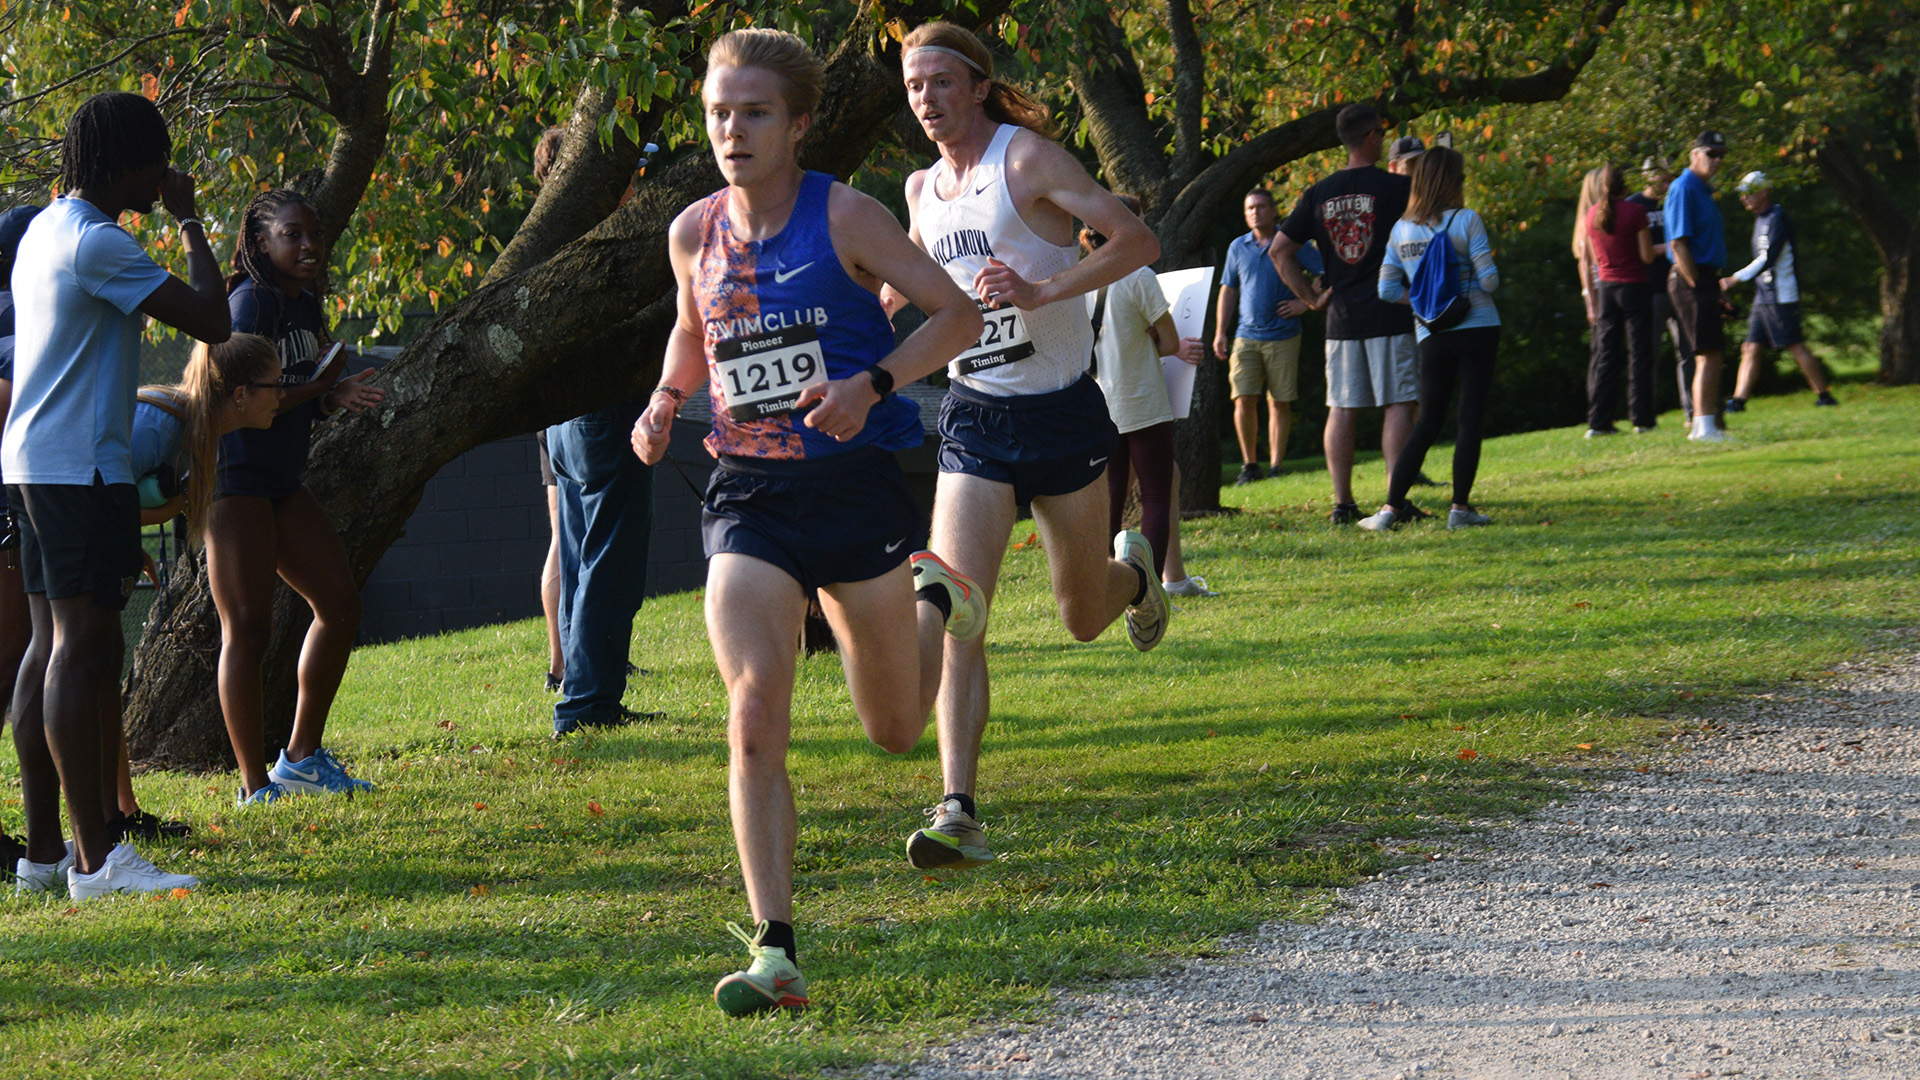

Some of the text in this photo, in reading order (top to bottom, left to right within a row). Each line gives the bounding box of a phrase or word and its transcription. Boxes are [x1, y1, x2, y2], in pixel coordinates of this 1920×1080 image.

[931, 228, 996, 267] VILLANOVA
[706, 307, 828, 341] SWIMCLUB
[741, 335, 784, 353] Pioneer
[970, 353, 1006, 369] Timing
[727, 352, 817, 397] 1219
[756, 398, 798, 414] Timing
